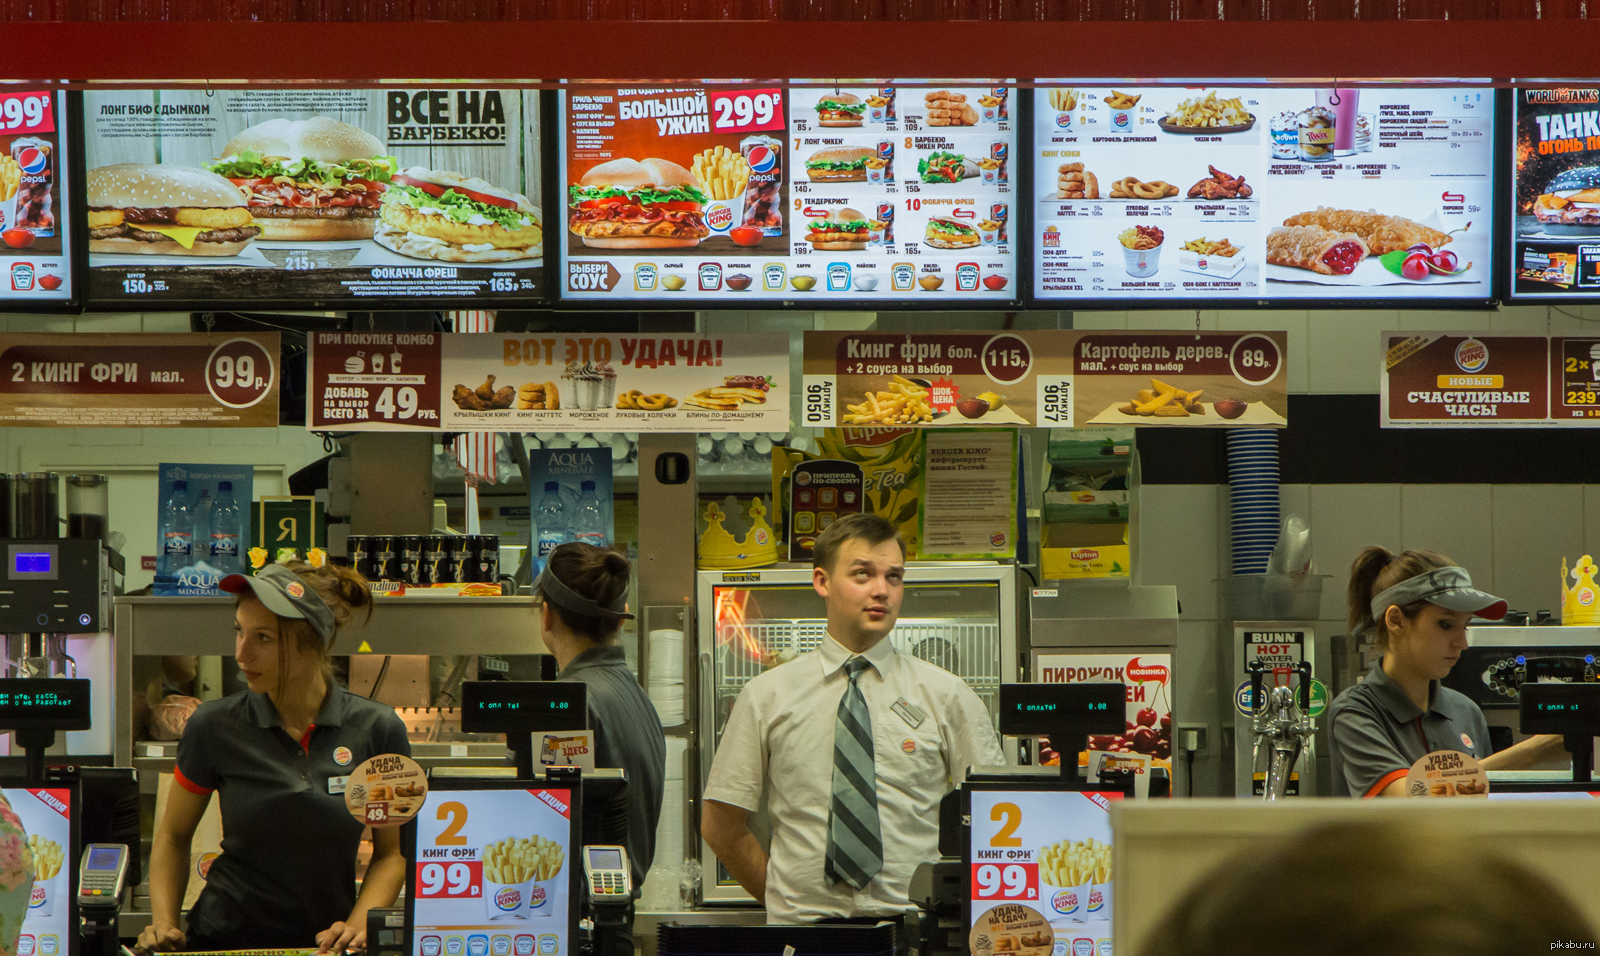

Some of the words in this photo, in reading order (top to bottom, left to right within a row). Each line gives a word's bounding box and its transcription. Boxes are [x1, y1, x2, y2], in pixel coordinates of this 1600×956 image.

[1526, 89, 1560, 104] WORLD
[1568, 89, 1599, 103] TANKS
[100, 104, 127, 115] ЛОНГ
[131, 104, 152, 116] БИФ
[153, 105, 159, 115] С
[161, 105, 210, 116] ДЫМКОМ
[387, 90, 449, 124] ВСЕ
[457, 90, 505, 124] НА
[572, 103, 603, 111] БАРБЕКЮ
[618, 92, 709, 120] БОЛЬШОЙ
[656, 114, 710, 136] УЖИН
[1535, 110, 1600, 142] ТАНК
[387, 126, 506, 140] БАРБЕКЮ!
[794, 138, 802, 150] 7
[904, 137, 913, 149] 8
[1538, 138, 1584, 155] ОГОНЬ
[20, 175, 46, 185] pepsi
[749, 175, 776, 185] pepsi
[794, 198, 803, 211] 9
[904, 199, 921, 211] 10
[922, 198, 953, 206] ФОКАЧЧА
[955, 198, 975, 206] ФРЕШ
[708, 207, 732, 219] BURGER
[709, 213, 733, 226] KING
[371, 267, 423, 279] ФОКАЧЧА
[424, 267, 458, 279] ФРЕШ
[570, 264, 608, 274] ВЫБЕРИ
[122, 280, 147, 293] 150
[489, 278, 513, 291] 165
[570, 273, 608, 290] СОУС
[319, 333, 341, 345] ПРИ
[344, 333, 393, 345] ПОКУПКЕ
[396, 333, 434, 346] КОМБО
[503, 338, 557, 367] ВОТ
[565, 338, 613, 366] ЭТО
[620, 338, 724, 369] УДАЧА!
[847, 338, 895, 359] Кинг
[900, 338, 942, 362] фри
[948, 345, 978, 359] бол.
[1075, 342, 1165, 362] Картофель
[1169, 346, 1223, 362] дерев.
[1459, 346, 1484, 358] BURGER
[1459, 352, 1486, 365] KING
[12, 362, 25, 383] 2
[31, 362, 85, 383] КИНГ
[91, 361, 138, 383] ФРИ
[151, 370, 185, 383] мал.
[856, 362, 864, 373] 2
[866, 364, 898, 376] соуса
[901, 364, 915, 373] на
[917, 363, 953, 376] выбор
[1075, 361, 1101, 371] мал.
[1112, 363, 1134, 373] соус
[1135, 363, 1147, 371] на
[1149, 361, 1178, 373] выбор
[1449, 377, 1493, 386] НОВЫЕ
[324, 387, 369, 400] ДОБАВЬ
[932, 387, 954, 396] ШОК-
[1406, 391, 1530, 404] СЧАСТЛИВЫЕ
[1567, 391, 1597, 404] 239
[375, 386, 418, 420] 49
[418, 409, 438, 420] РУБ.
[807, 384, 821, 422] 9050
[821, 380, 833, 421] Артикул
[932, 395, 954, 405] ЦЕНА
[1037, 384, 1053, 422] 9057
[1054, 381, 1064, 421] Артикул
[323, 408, 354, 419] ВСЕГО
[356, 408, 369, 419] ЗА
[569, 411, 610, 419] МОРОЖЕНОЕ
[616, 411, 646, 419] ЛУКОВЫЕ
[647, 411, 678, 419] КОЛЕЧКИ
[687, 411, 709, 419] БЛИНЫ
[710, 411, 765, 420] ПО-ДОМАШНЕМУ
[1444, 404, 1498, 416] ЧАСЫ
[548, 452, 594, 467] AQUA
[548, 466, 594, 474] MINERALE
[873, 468, 908, 486] Tea
[275, 516, 297, 542] Я
[1071, 551, 1098, 560] Lipton
[177, 573, 221, 589] AQUA
[177, 588, 221, 596] MINERALE
[1252, 633, 1296, 643] BUNN
[1257, 645, 1290, 655] HOT
[1042, 667, 1126, 684] ПИРОЖОК
[1130, 668, 1166, 676] НОВИНКА
[550, 701, 568, 709] 0.00
[1026, 703, 1056, 711] оплате:
[1088, 702, 1107, 710] 0.00
[562, 746, 589, 757] ЗДЕСЬ
[370, 756, 401, 768] УДАЧА
[1428, 753, 1460, 765] УДАЧА
[378, 763, 404, 773] СДАЧУ
[1424, 764, 1436, 772] НА
[1437, 760, 1464, 770] СДАЧУ
[36, 789, 67, 813] АКЦИЯ
[537, 790, 568, 813] АКЦИЯ
[1091, 793, 1111, 810] АКЦ
[435, 801, 468, 846] 2
[990, 802, 1022, 847] 2
[423, 848, 449, 858] КИНГ
[977, 850, 1004, 859] КИНГ
[497, 889, 520, 901] BURGER
[498, 895, 521, 907] KING
[1054, 892, 1077, 905] BURGER
[991, 905, 1024, 918] УДАЧА
[1055, 899, 1079, 911] KING
[988, 915, 1002, 925] НА
[1003, 912, 1028, 924] СДАЧУ
